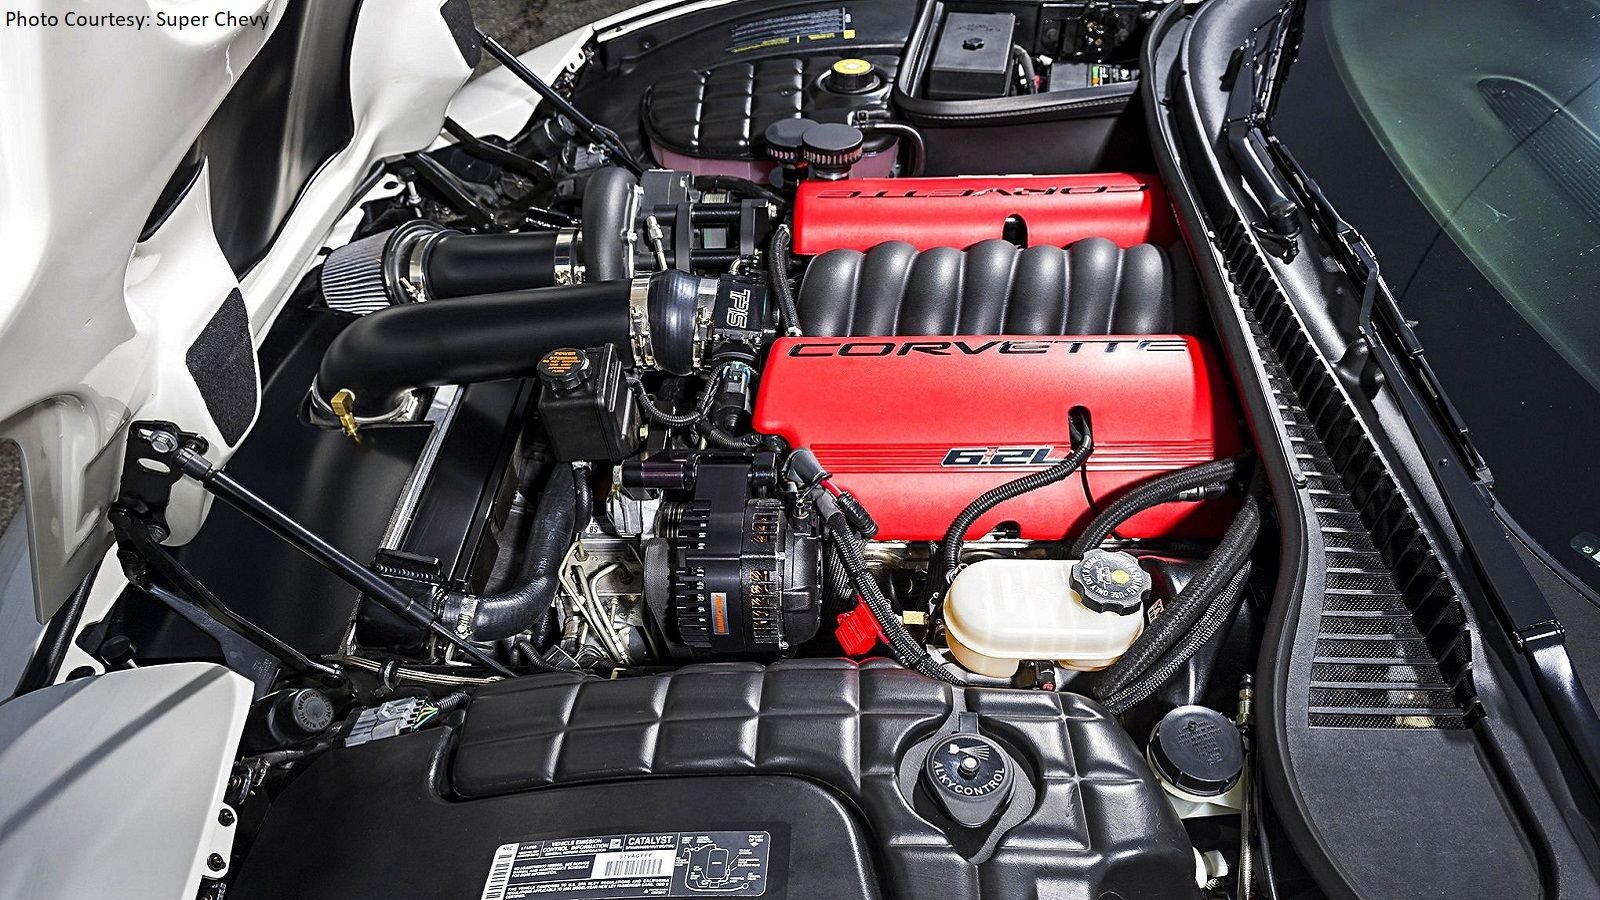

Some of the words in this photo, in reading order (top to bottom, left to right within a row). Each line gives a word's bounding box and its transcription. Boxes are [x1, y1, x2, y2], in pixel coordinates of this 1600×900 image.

[726, 288, 751, 329] TPIS
[787, 338, 1189, 358] CORVETTE
[1090, 584, 1109, 597] ONLY
[934, 760, 1005, 796] ALKYCONTROL
[552, 839, 574, 847] VEHICLE
[628, 835, 673, 845] CATALYST
